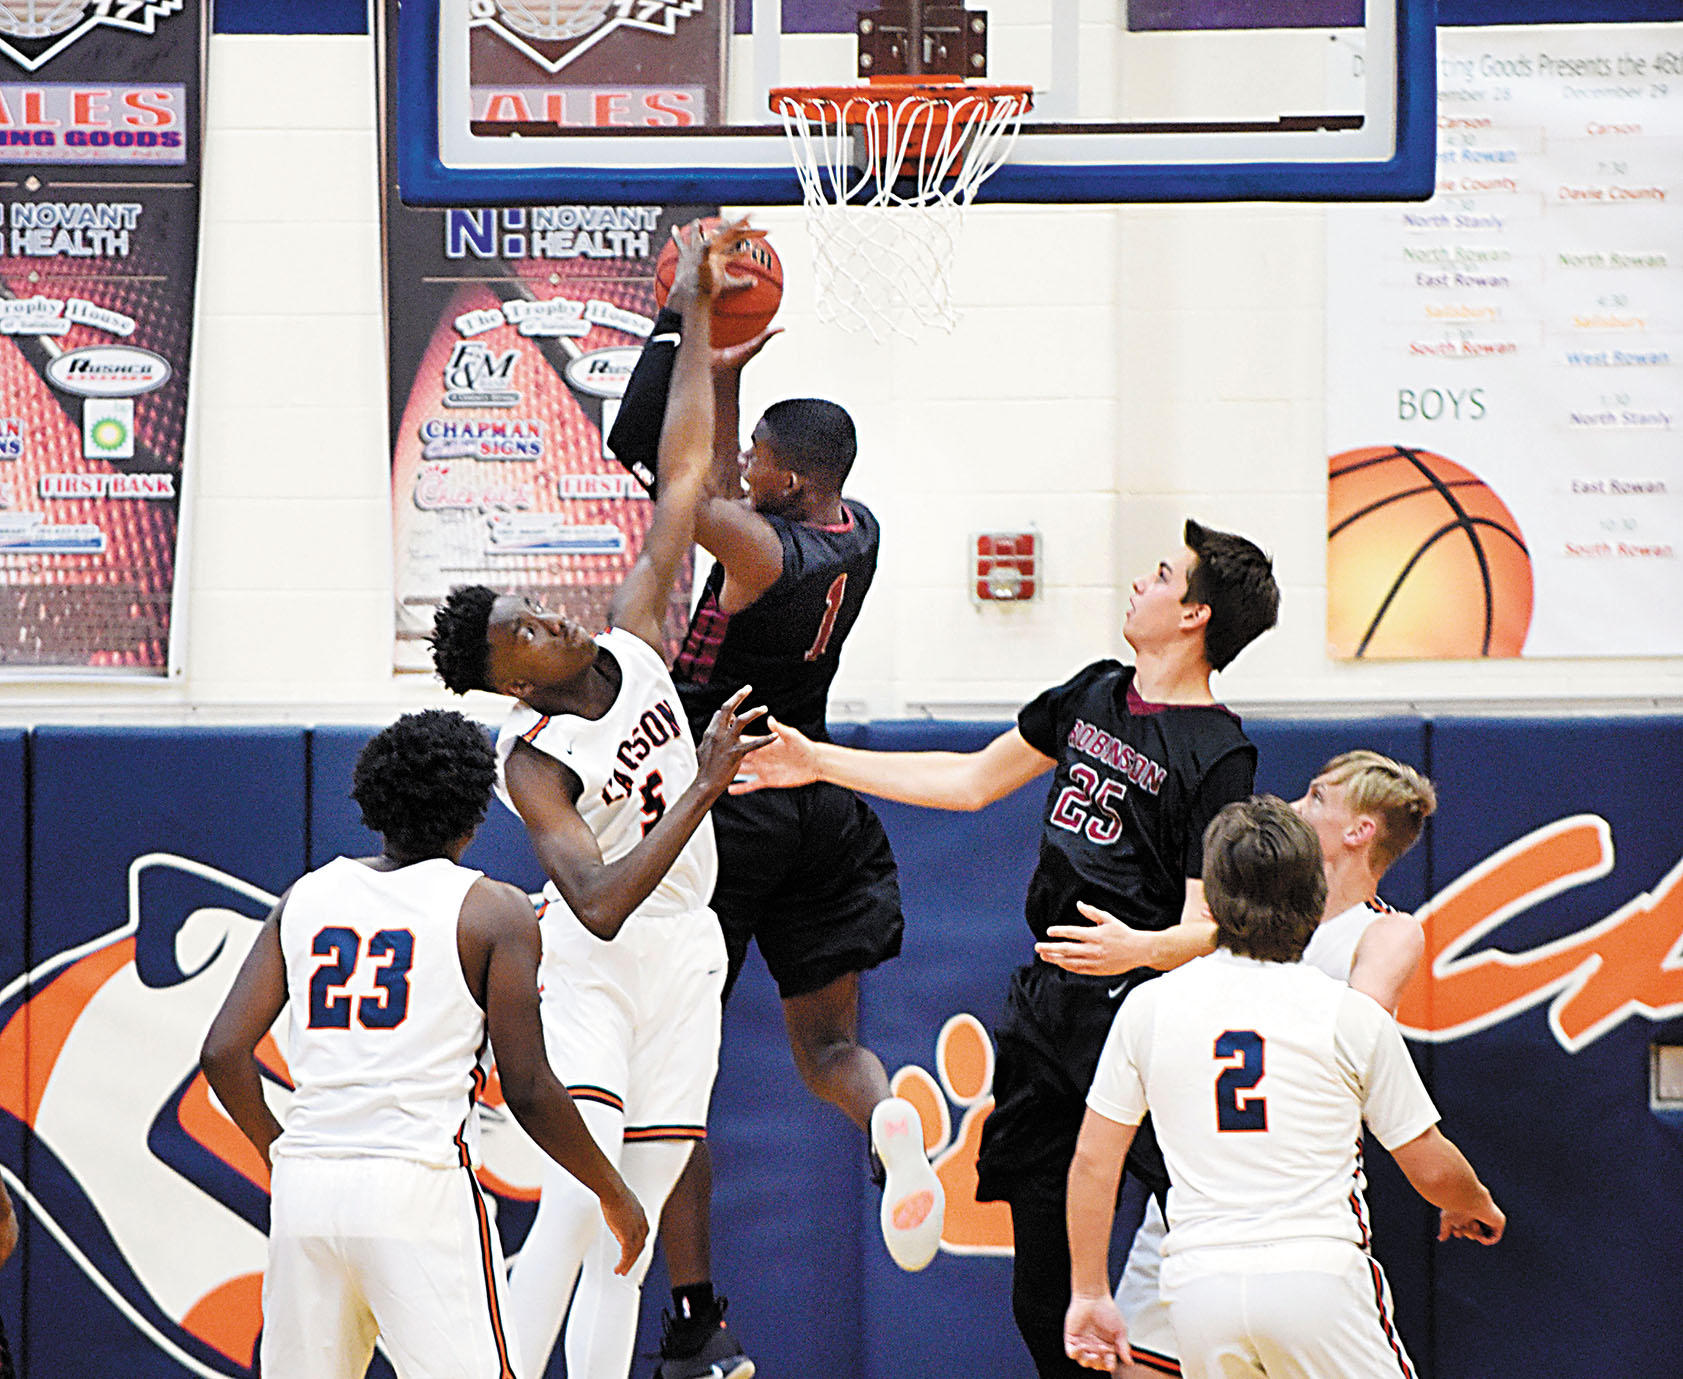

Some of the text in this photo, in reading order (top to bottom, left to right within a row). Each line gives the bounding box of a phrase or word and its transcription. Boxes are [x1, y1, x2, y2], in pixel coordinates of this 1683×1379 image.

[65, 131, 181, 147] GOODS
[11, 203, 141, 229] NOVANT
[531, 207, 662, 230] NOVANT
[11, 230, 128, 256] HEALTH
[531, 231, 650, 256] HEALTH
[1455, 272, 1509, 287] Rowan
[464, 313, 498, 330] The
[1398, 387, 1487, 420] BOYS
[426, 420, 540, 438] CHAPMAN
[480, 441, 541, 454] SIGNS
[44, 477, 171, 493] FIRST BANK
[564, 477, 622, 493] FIRST
[804, 572, 848, 662] 1
[1050, 762, 1127, 845] 25
[306, 925, 416, 1031] 23
[1212, 1029, 1268, 1133] 2
